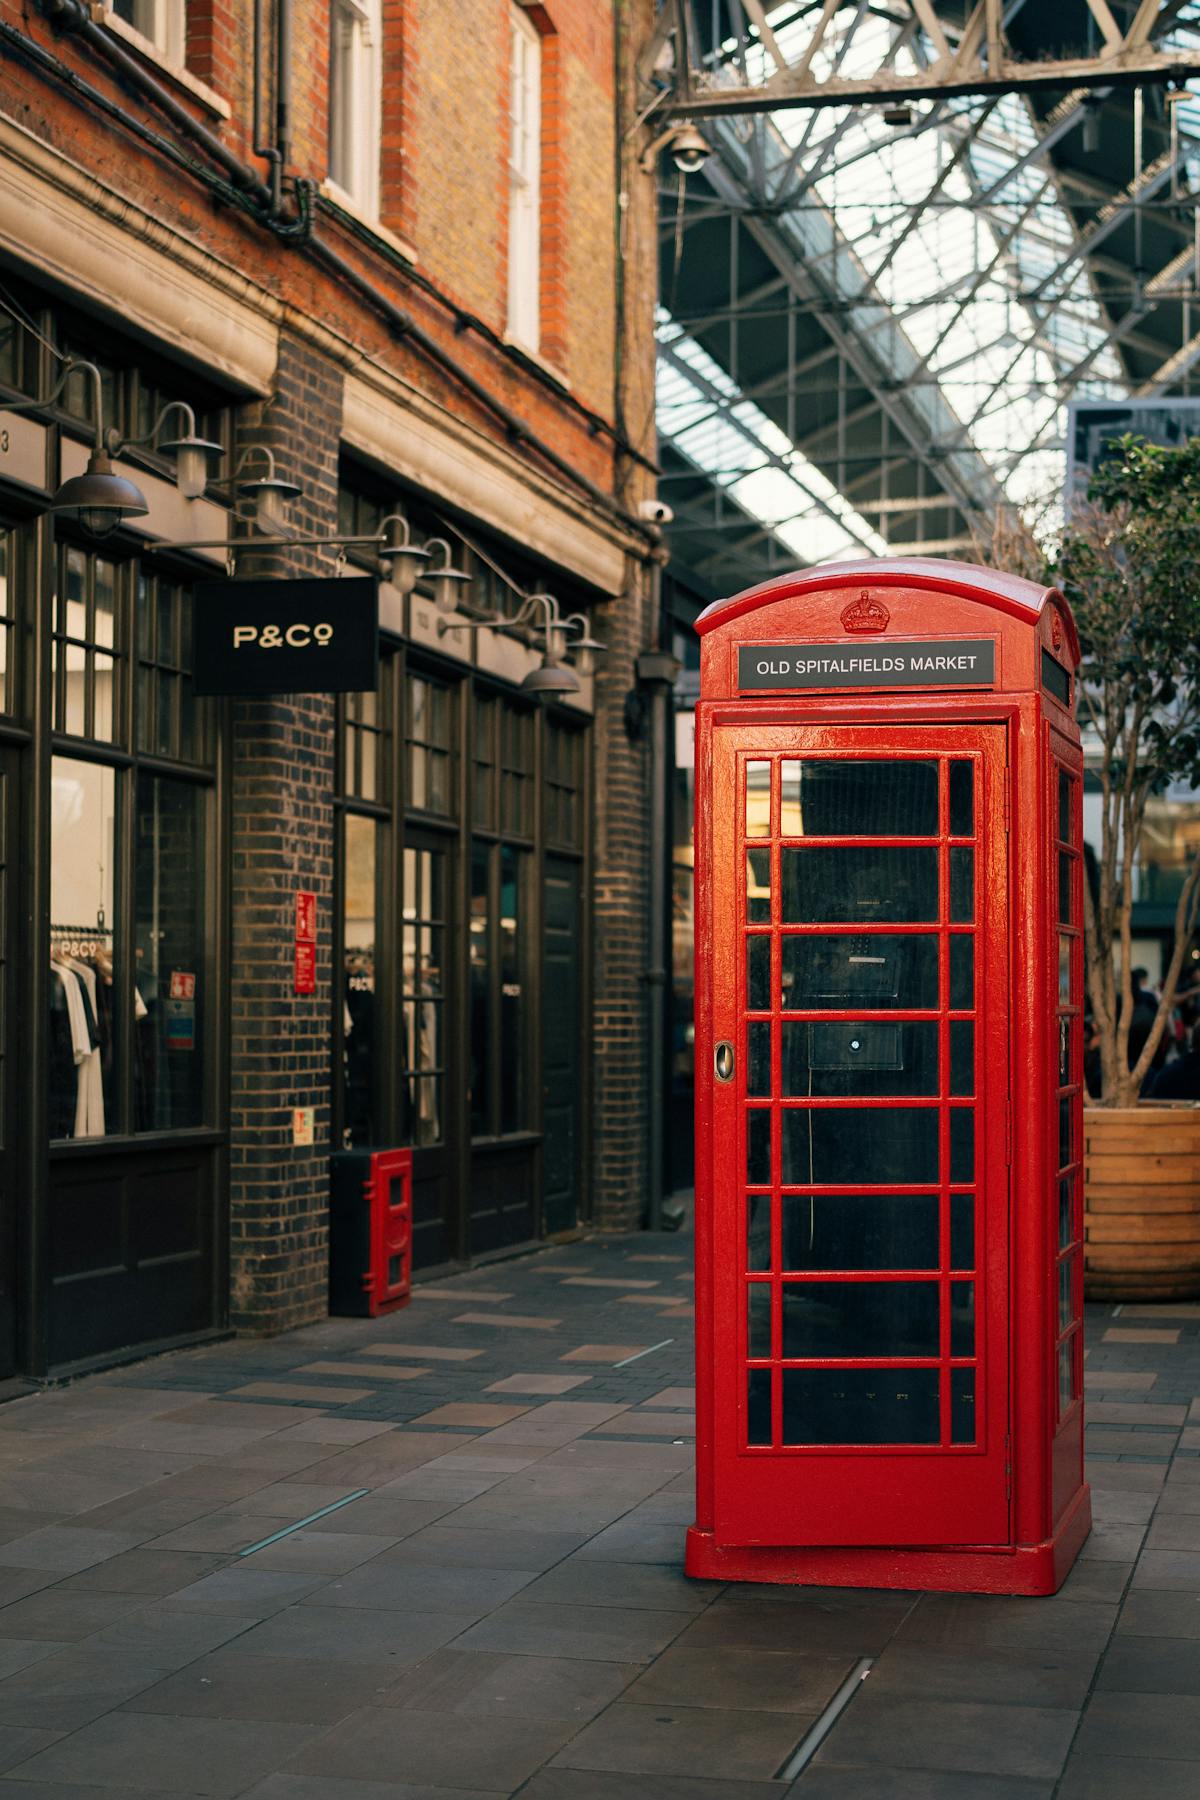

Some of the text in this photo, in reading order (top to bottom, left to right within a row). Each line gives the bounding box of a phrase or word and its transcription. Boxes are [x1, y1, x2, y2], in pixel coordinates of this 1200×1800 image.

[756, 656, 977, 675] OLD SPITALFIELDS MARKET
